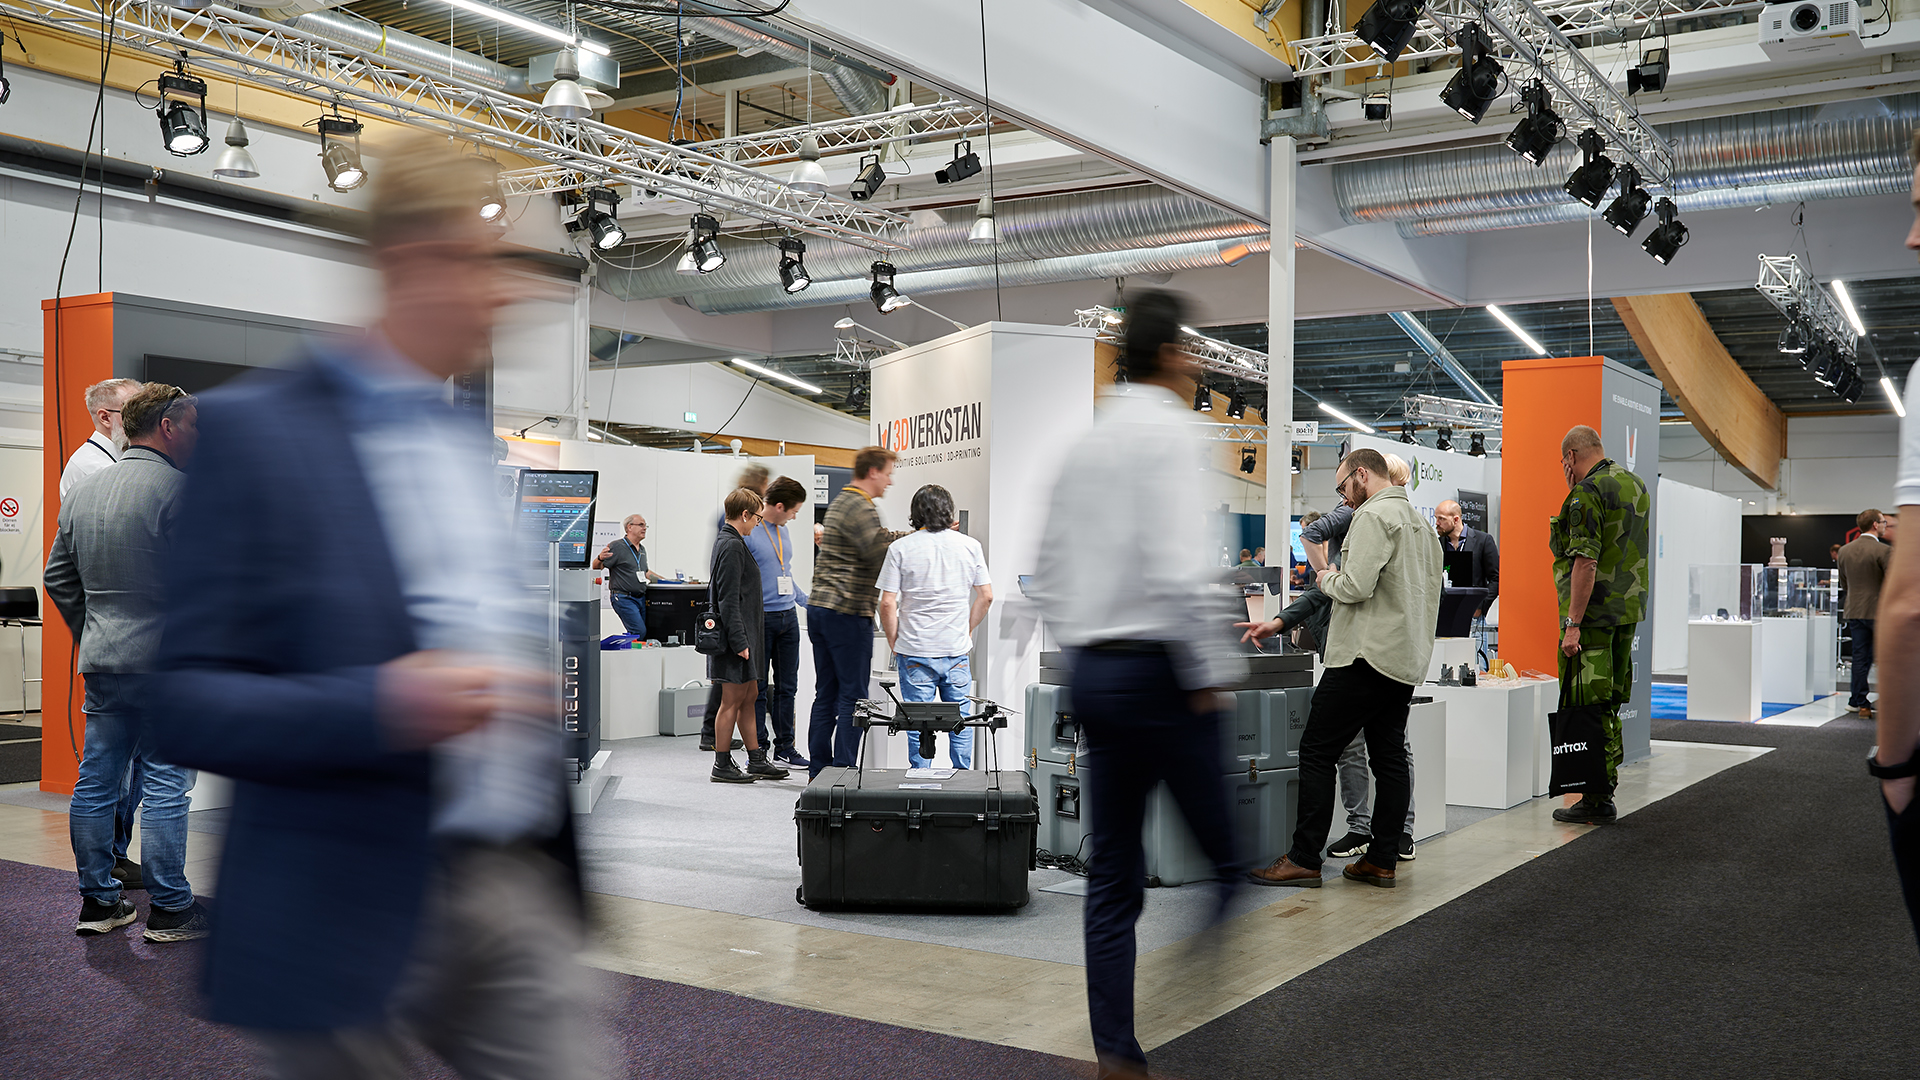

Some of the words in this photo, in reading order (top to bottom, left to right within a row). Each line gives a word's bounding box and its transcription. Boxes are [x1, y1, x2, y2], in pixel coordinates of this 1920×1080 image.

[893, 401, 982, 453] 3DVERKSTAN
[915, 453, 943, 466] SOLUTIONS
[946, 446, 982, 462] 3D-PRINTING
[1421, 462, 1443, 482] ExOne
